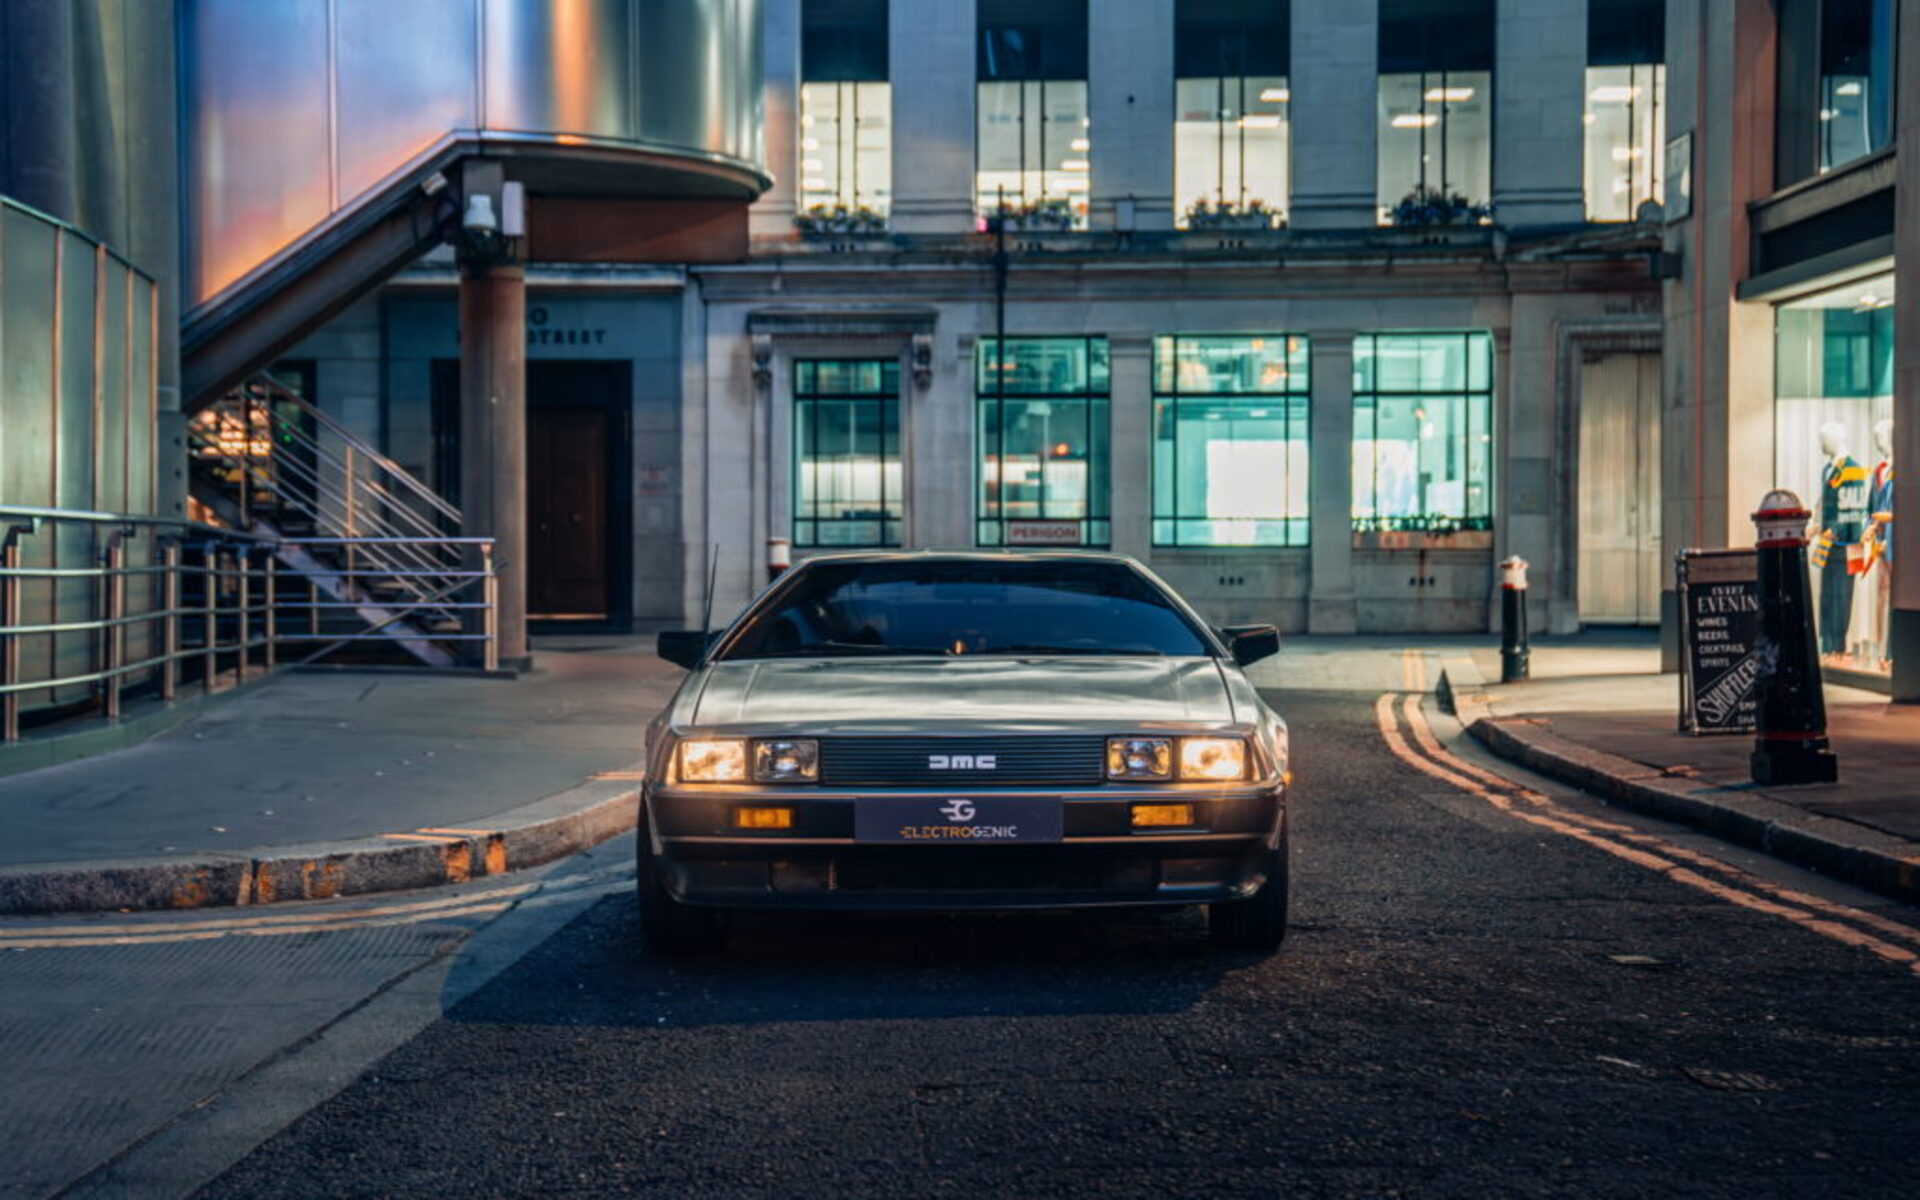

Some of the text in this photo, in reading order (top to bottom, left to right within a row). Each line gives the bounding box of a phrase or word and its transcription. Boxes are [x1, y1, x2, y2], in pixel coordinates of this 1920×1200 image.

[1013, 527, 1077, 537] PERIGON
[1697, 595, 1759, 613] EVENIN
[1696, 617, 1729, 628] WINES
[1697, 631, 1730, 642] BEERS
[1698, 643, 1746, 655] COCKTAILS
[1700, 657, 1731, 669] SPIRITS
[899, 826, 1018, 839] ELECTROGENIC
